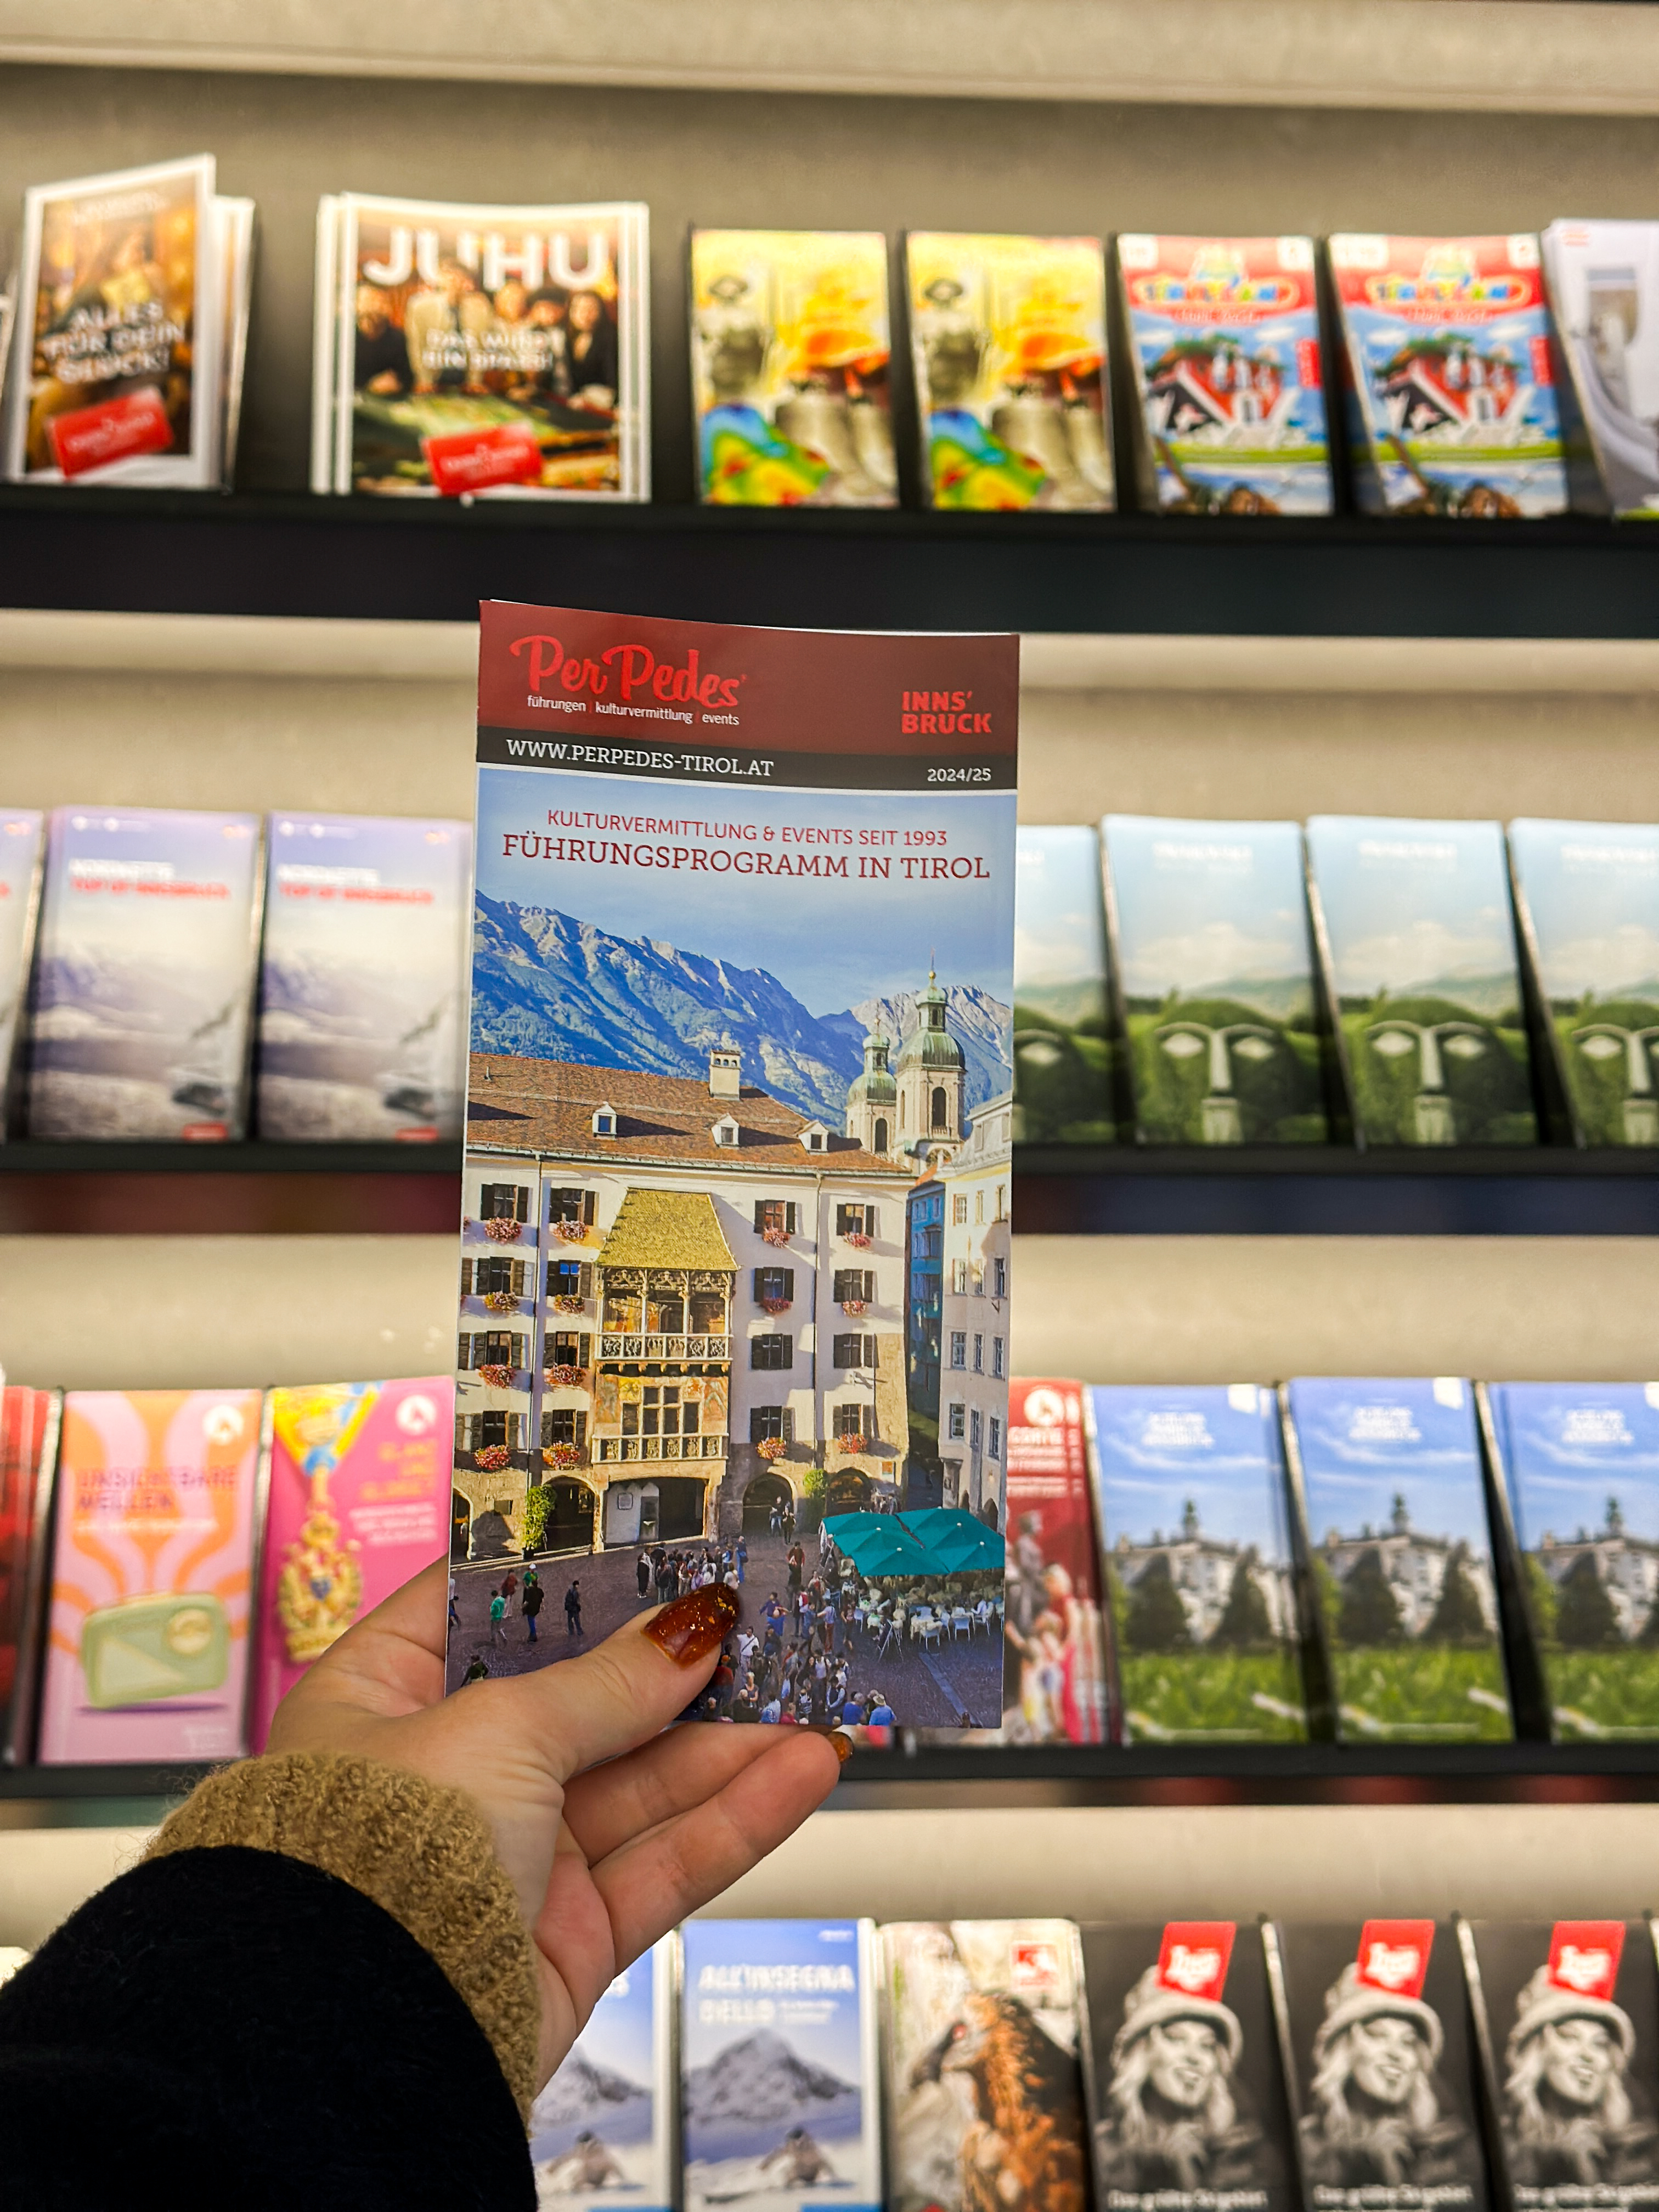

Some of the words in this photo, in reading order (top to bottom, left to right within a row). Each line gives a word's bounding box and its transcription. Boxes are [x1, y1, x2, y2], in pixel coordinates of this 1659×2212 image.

[363, 225, 608, 291] JUHU
[509, 635, 607, 695] Per
[527, 695, 586, 713] führungen
[595, 702, 693, 724] kulturvermittlung
[702, 714, 740, 725] events
[901, 713, 992, 734] BRUCK
[506, 739, 773, 777] WWW.PERPEDES-TIROL.AT
[927, 768, 992, 782] 2024/25
[548, 810, 757, 840] KULTURVERMITTLUNG
[763, 826, 775, 841] &
[782, 827, 853, 845] EVENTS
[859, 830, 898, 846] SEIT
[904, 830, 947, 846] 1993
[503, 831, 849, 878] FÜHRUNGSPROGRAMM
[859, 857, 892, 878] IN
[900, 857, 990, 879] TIROL
